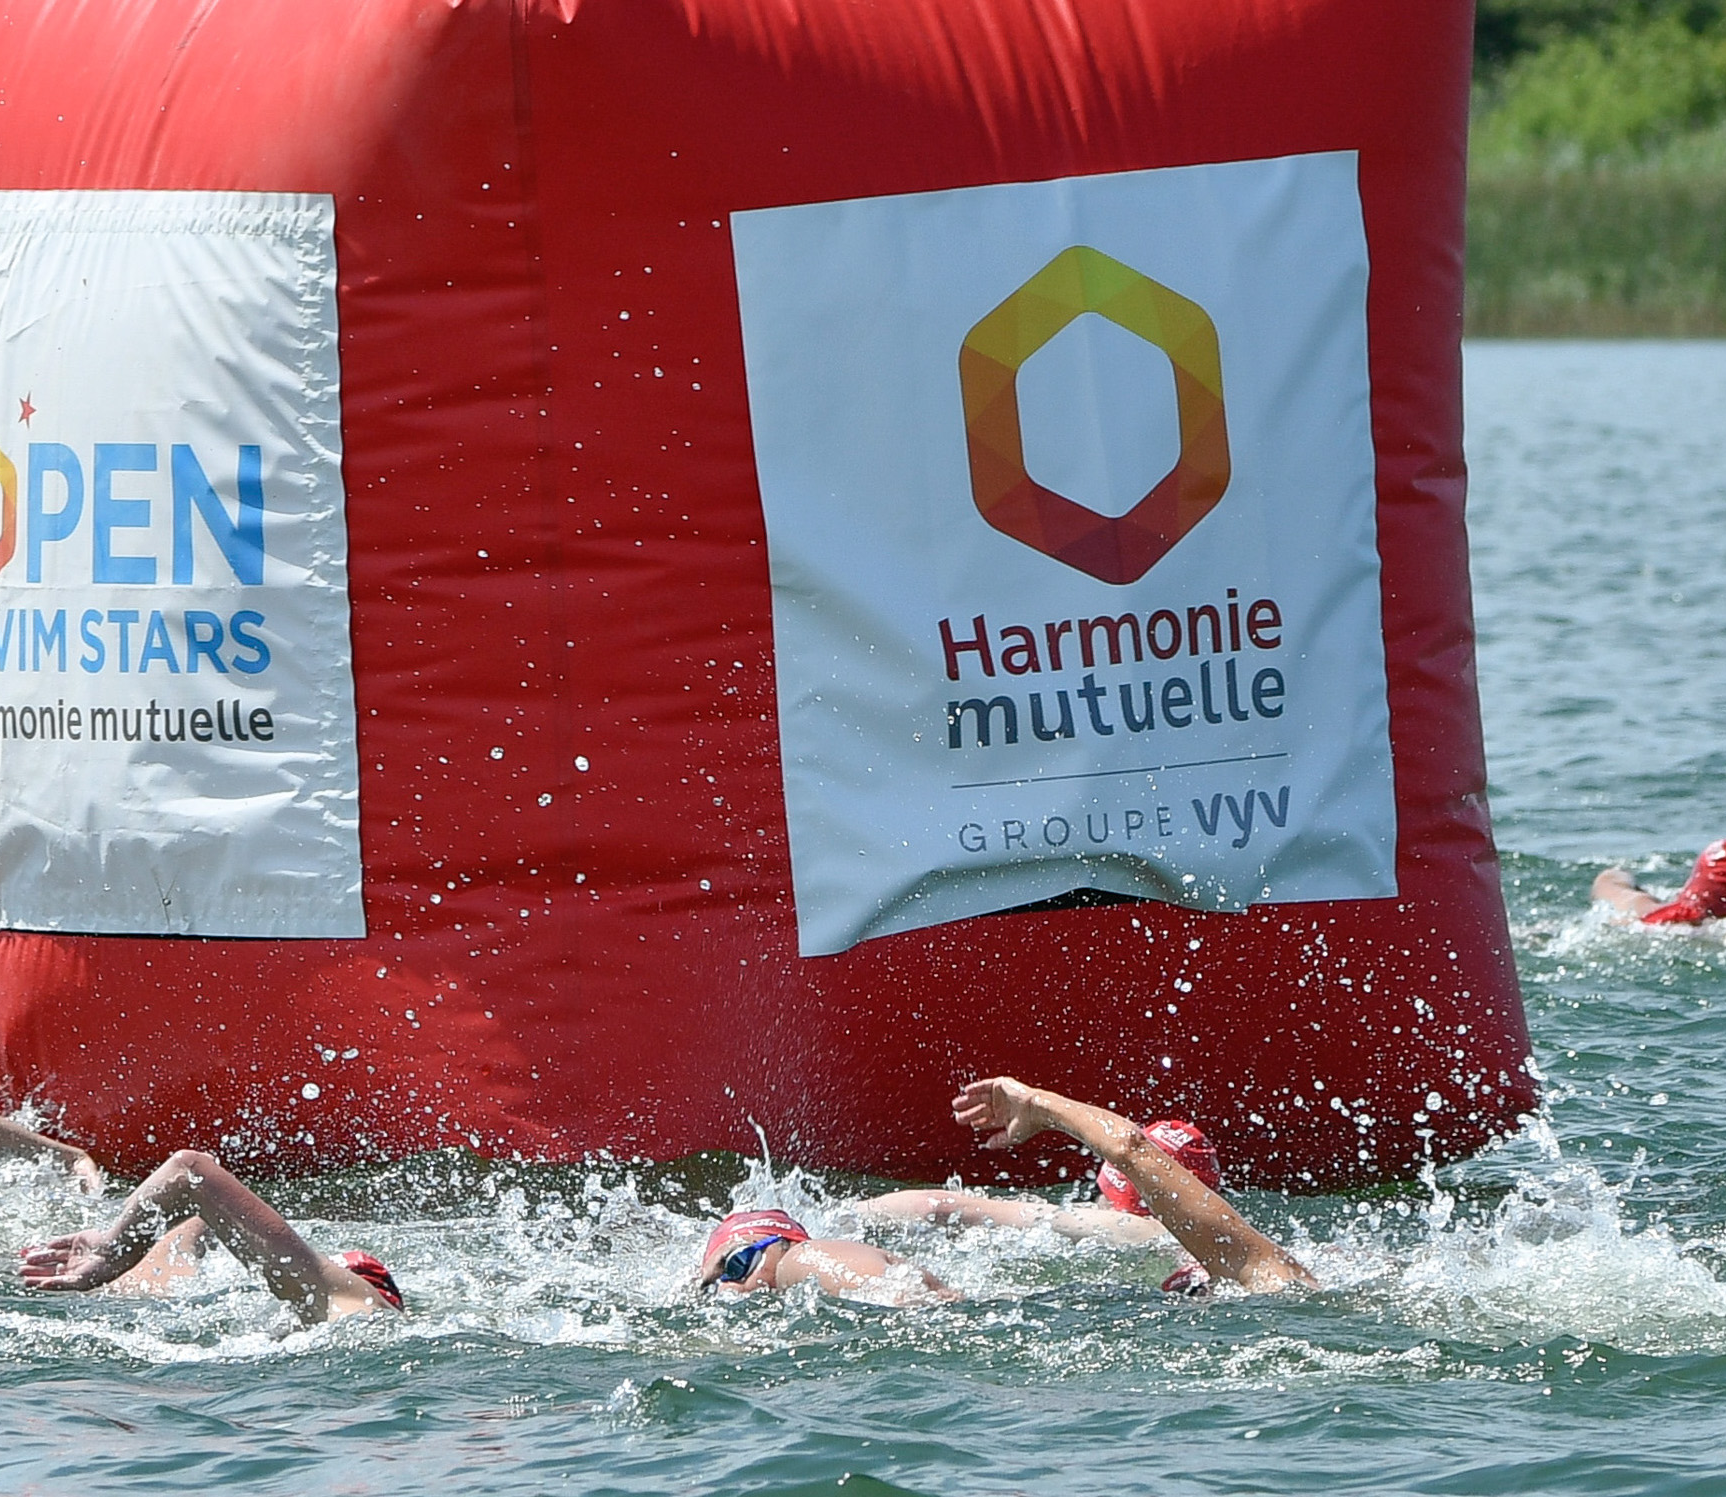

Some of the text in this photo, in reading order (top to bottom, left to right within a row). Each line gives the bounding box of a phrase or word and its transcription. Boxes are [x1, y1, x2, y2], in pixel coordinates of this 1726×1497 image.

[80, 609, 271, 674] STARS
[938, 588, 1283, 681] Harmonie
[91, 699, 274, 742] mutuelle
[947, 657, 1285, 749] mutuelle
[959, 806, 1173, 852] GROUPE
